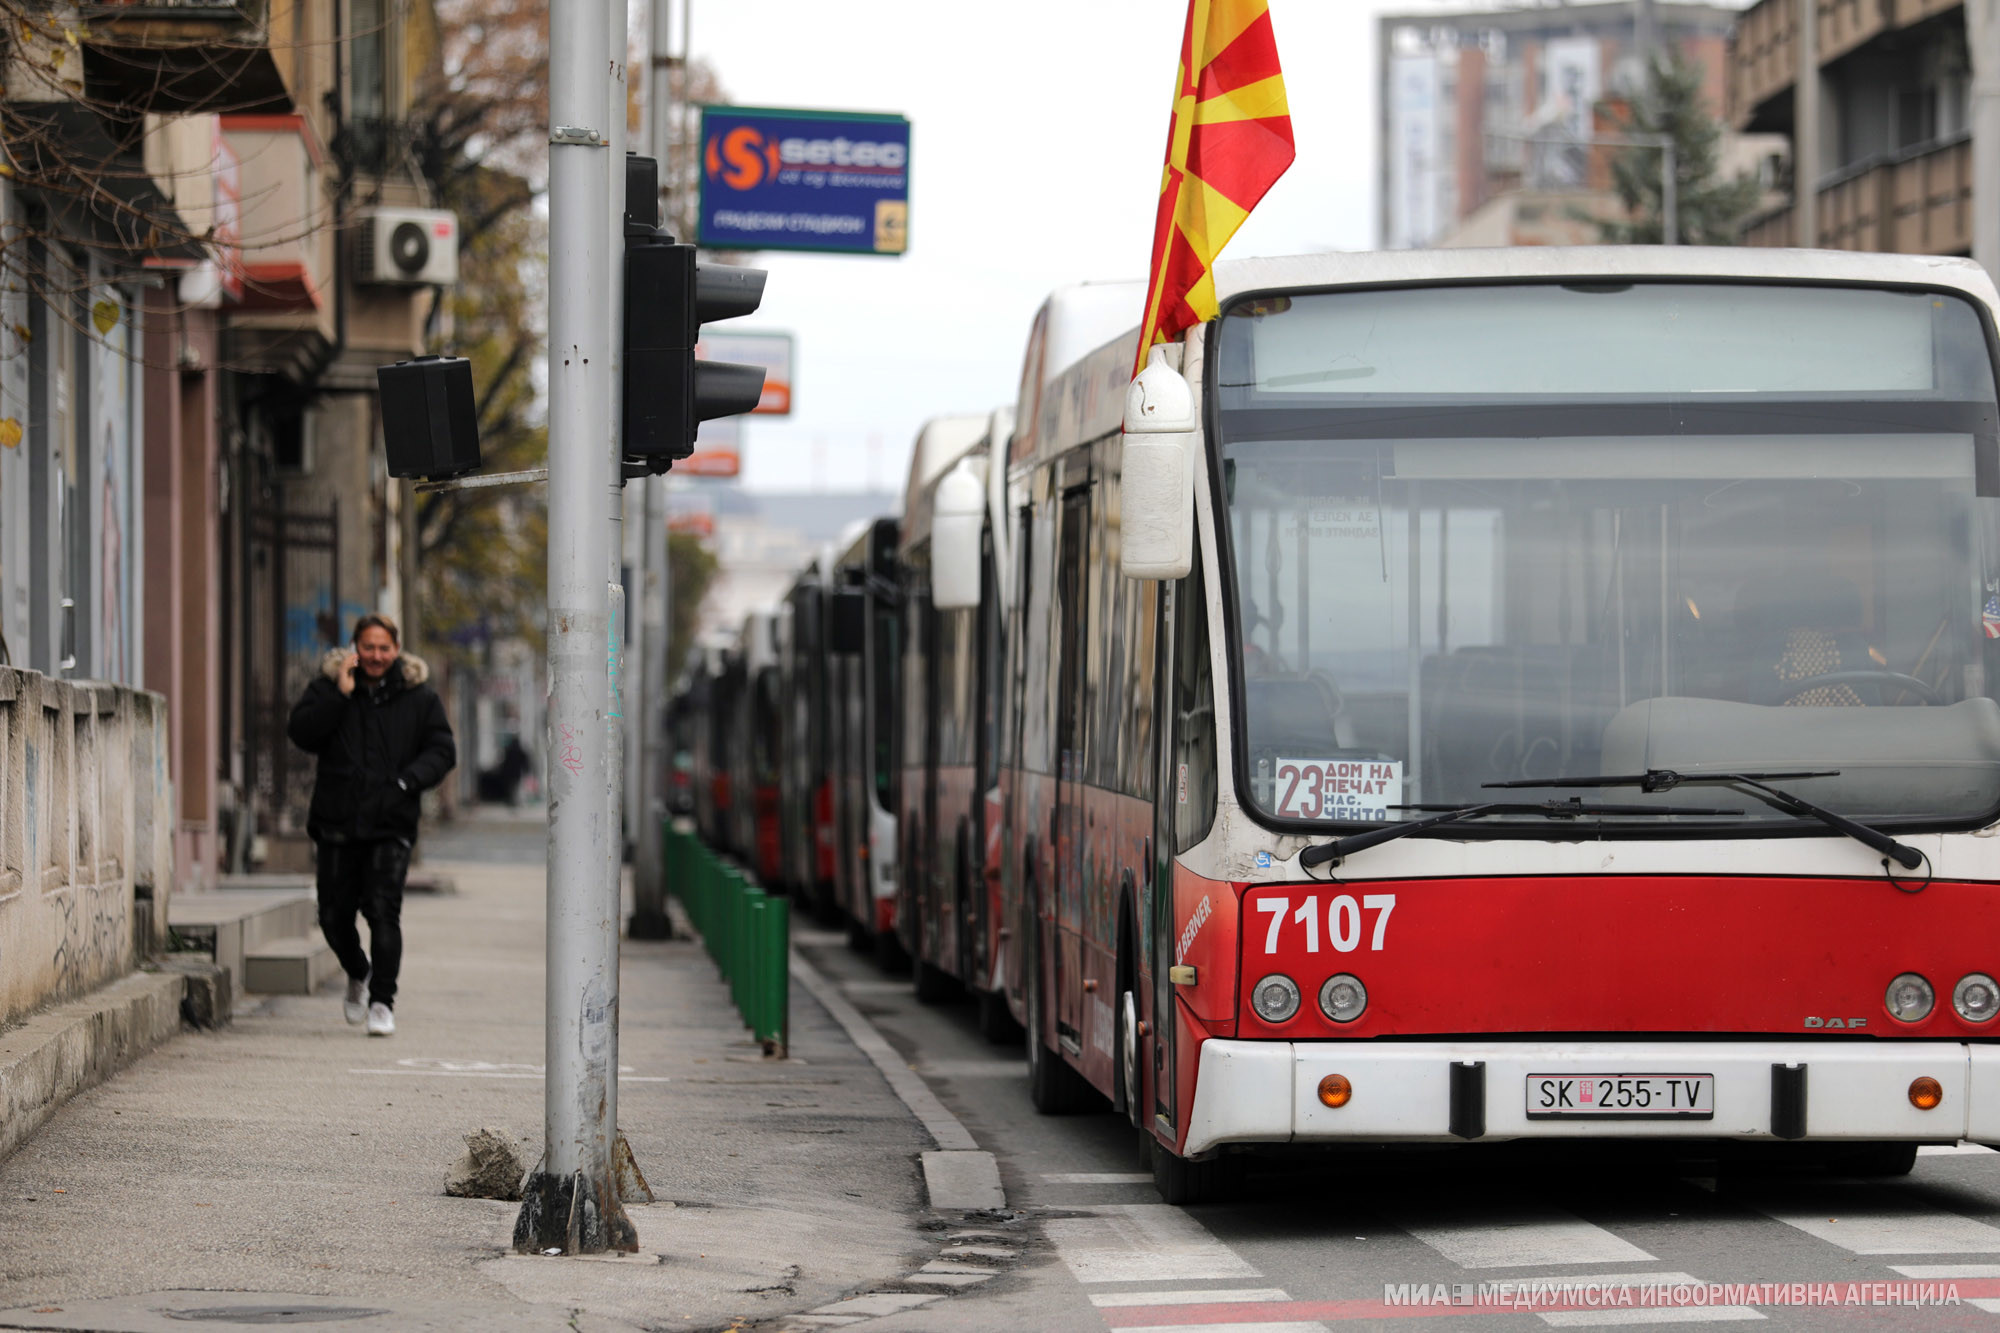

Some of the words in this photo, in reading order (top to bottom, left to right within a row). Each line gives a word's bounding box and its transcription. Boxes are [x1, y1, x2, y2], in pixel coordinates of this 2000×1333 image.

[1325, 763, 1362, 778] ДОМ
[1370, 764, 1393, 779] НА
[1278, 765, 1323, 818] 23
[1324, 779, 1387, 795] ПЕЧАТ
[1324, 795, 1361, 805] НАС.
[1324, 807, 1386, 821] ЧЕНТО
[1181, 894, 1213, 956] BERNER
[1256, 893, 1396, 954] 7107
[1804, 1016, 1867, 1028] DAF
[1540, 1080, 1574, 1107] SK
